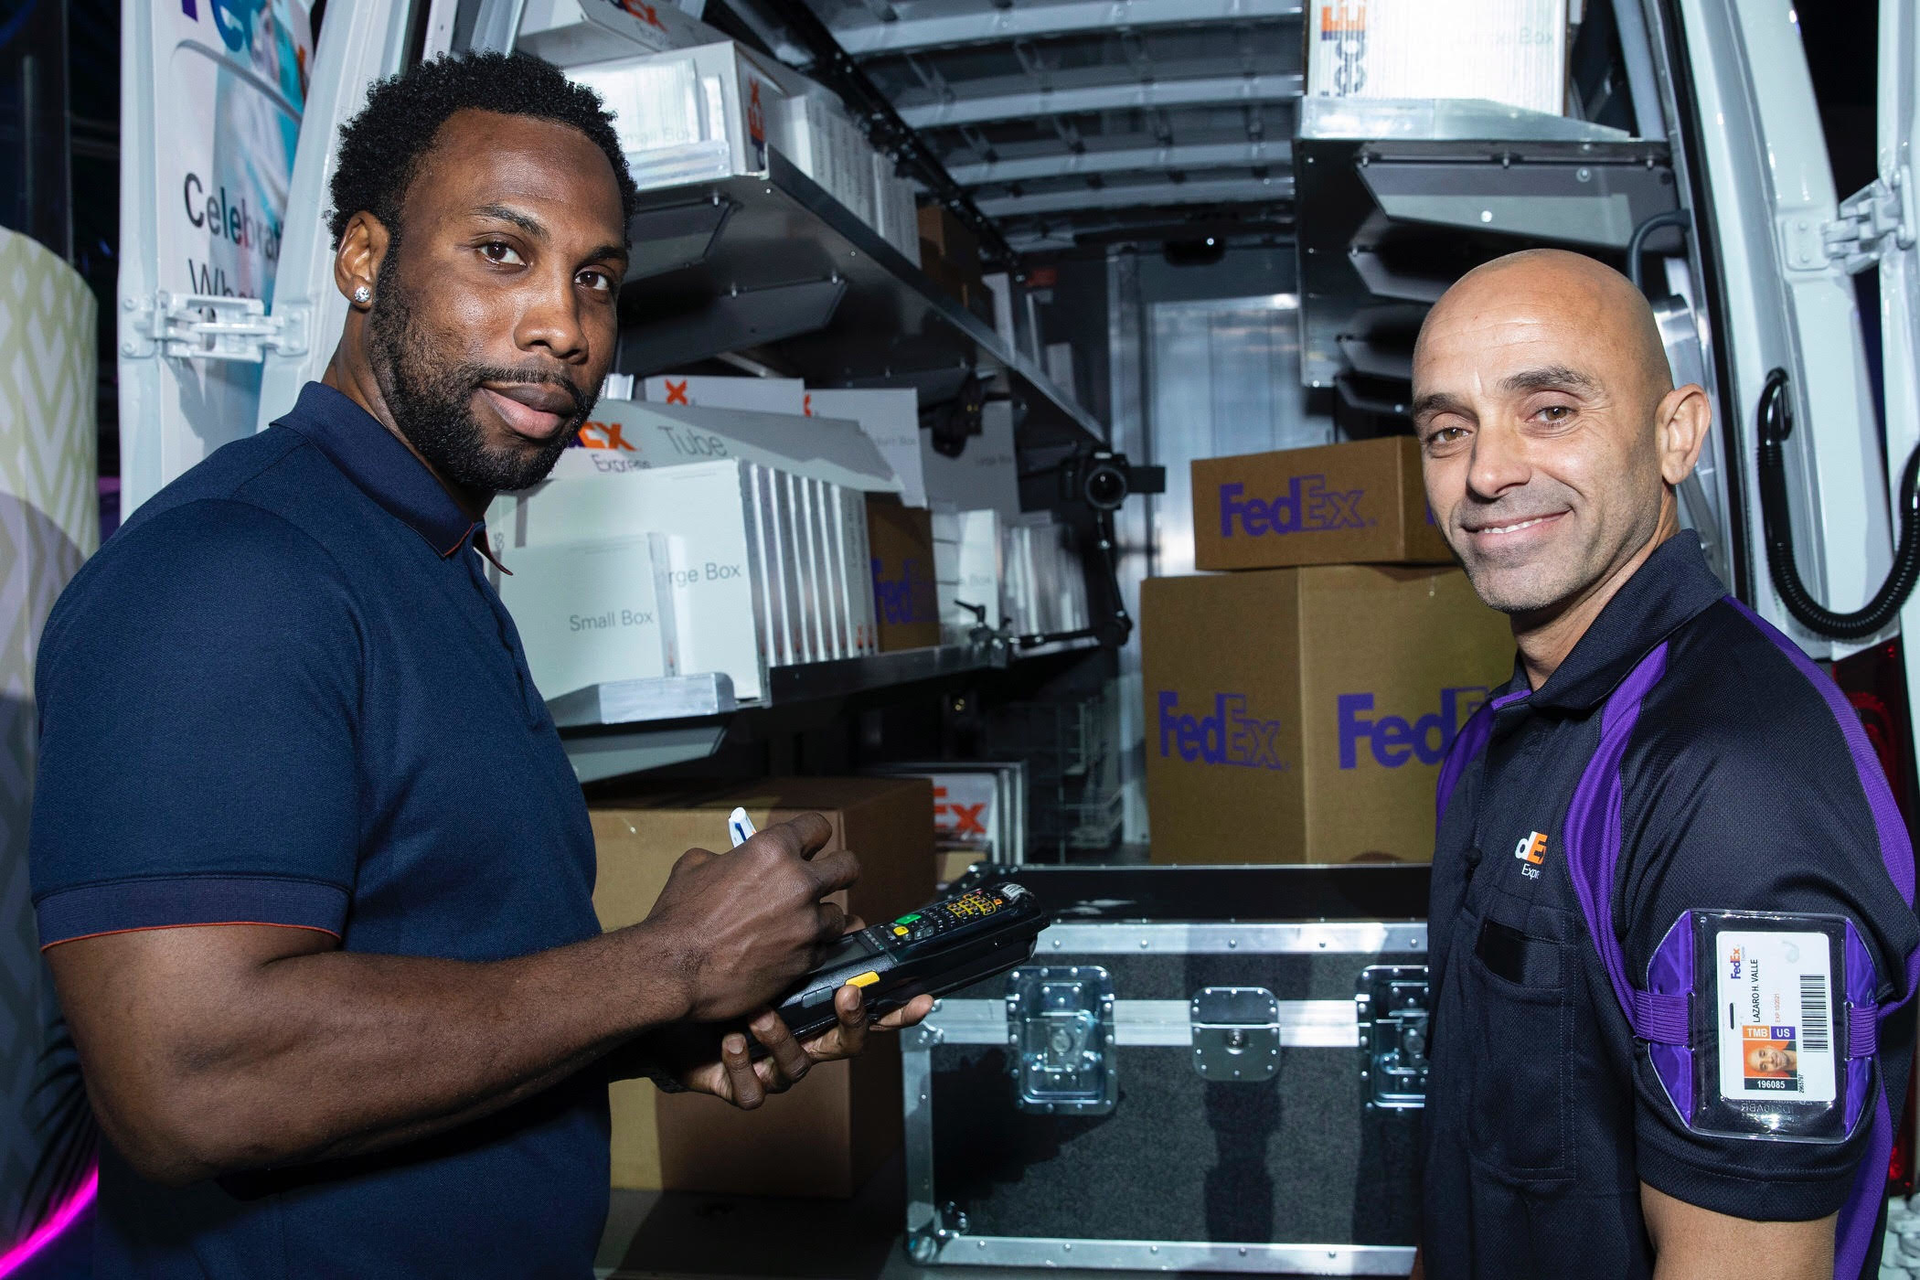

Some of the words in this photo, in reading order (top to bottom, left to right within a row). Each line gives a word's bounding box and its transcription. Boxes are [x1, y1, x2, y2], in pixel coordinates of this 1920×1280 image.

[184, 172, 286, 262] Celebra
[657, 425, 728, 457] Tube
[1219, 474, 1366, 538] FedEx
[668, 567, 699, 587] rge
[705, 562, 742, 581] Box
[569, 609, 616, 631] Small
[622, 608, 654, 627] Box
[1158, 690, 1283, 771] FedEx
[1730, 948, 1742, 979] FedEx
[1750, 959, 1759, 983] VALLE
[1751, 992, 1761, 1023] LAZARO
[1747, 1028, 1768, 1038] TMB
[1776, 1028, 1790, 1038] US
[1757, 1080, 1786, 1089] 196085
